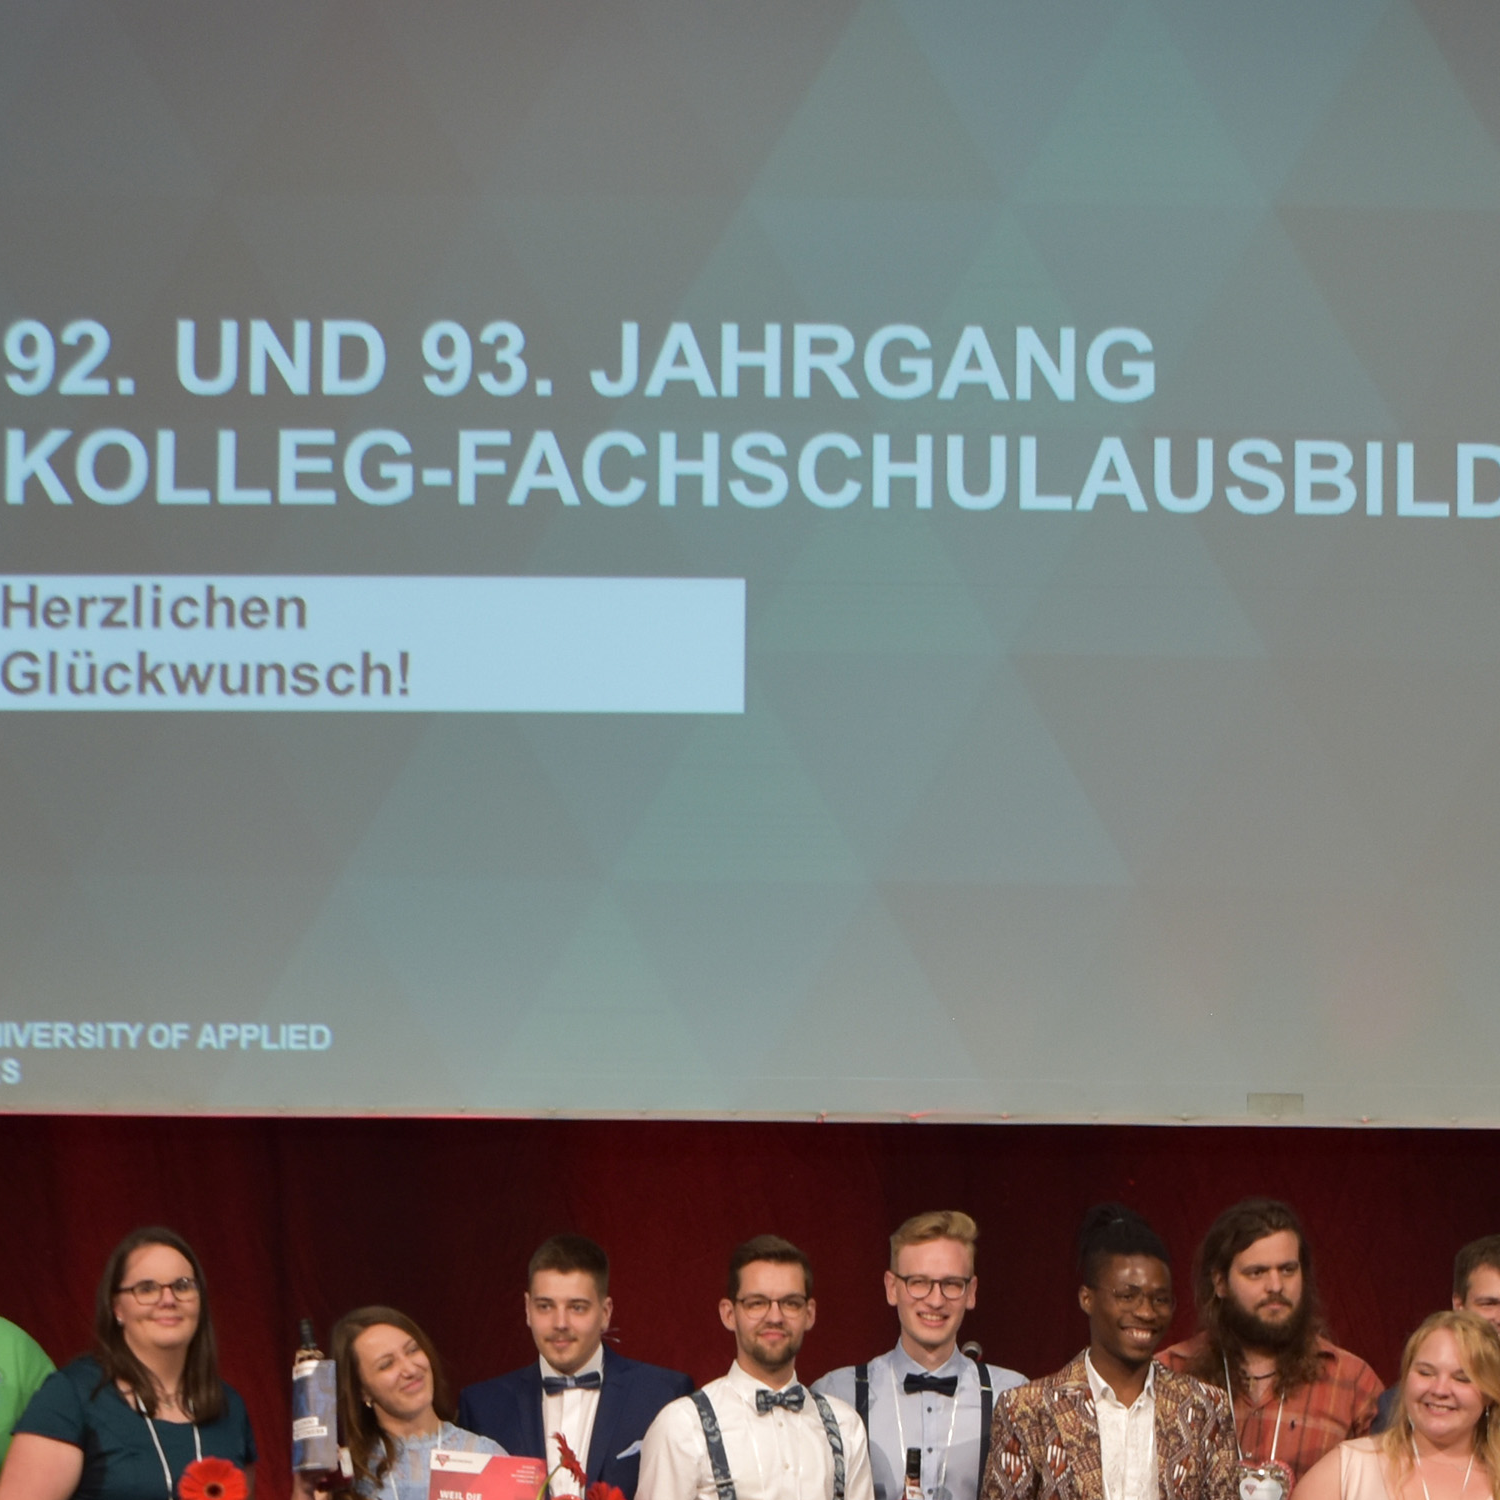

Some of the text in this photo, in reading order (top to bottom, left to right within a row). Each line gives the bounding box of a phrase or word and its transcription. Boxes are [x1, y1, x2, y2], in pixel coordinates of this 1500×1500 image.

[3, 319, 1157, 403] 92. UND 93. JAHRGANG
[0, 583, 308, 630] Herzlichen
[0, 648, 411, 697] Glückwunsch!
[148, 1023, 190, 1049] OF
[198, 1024, 332, 1050] APPLIED
[440, 1490, 464, 1500] WEIL
